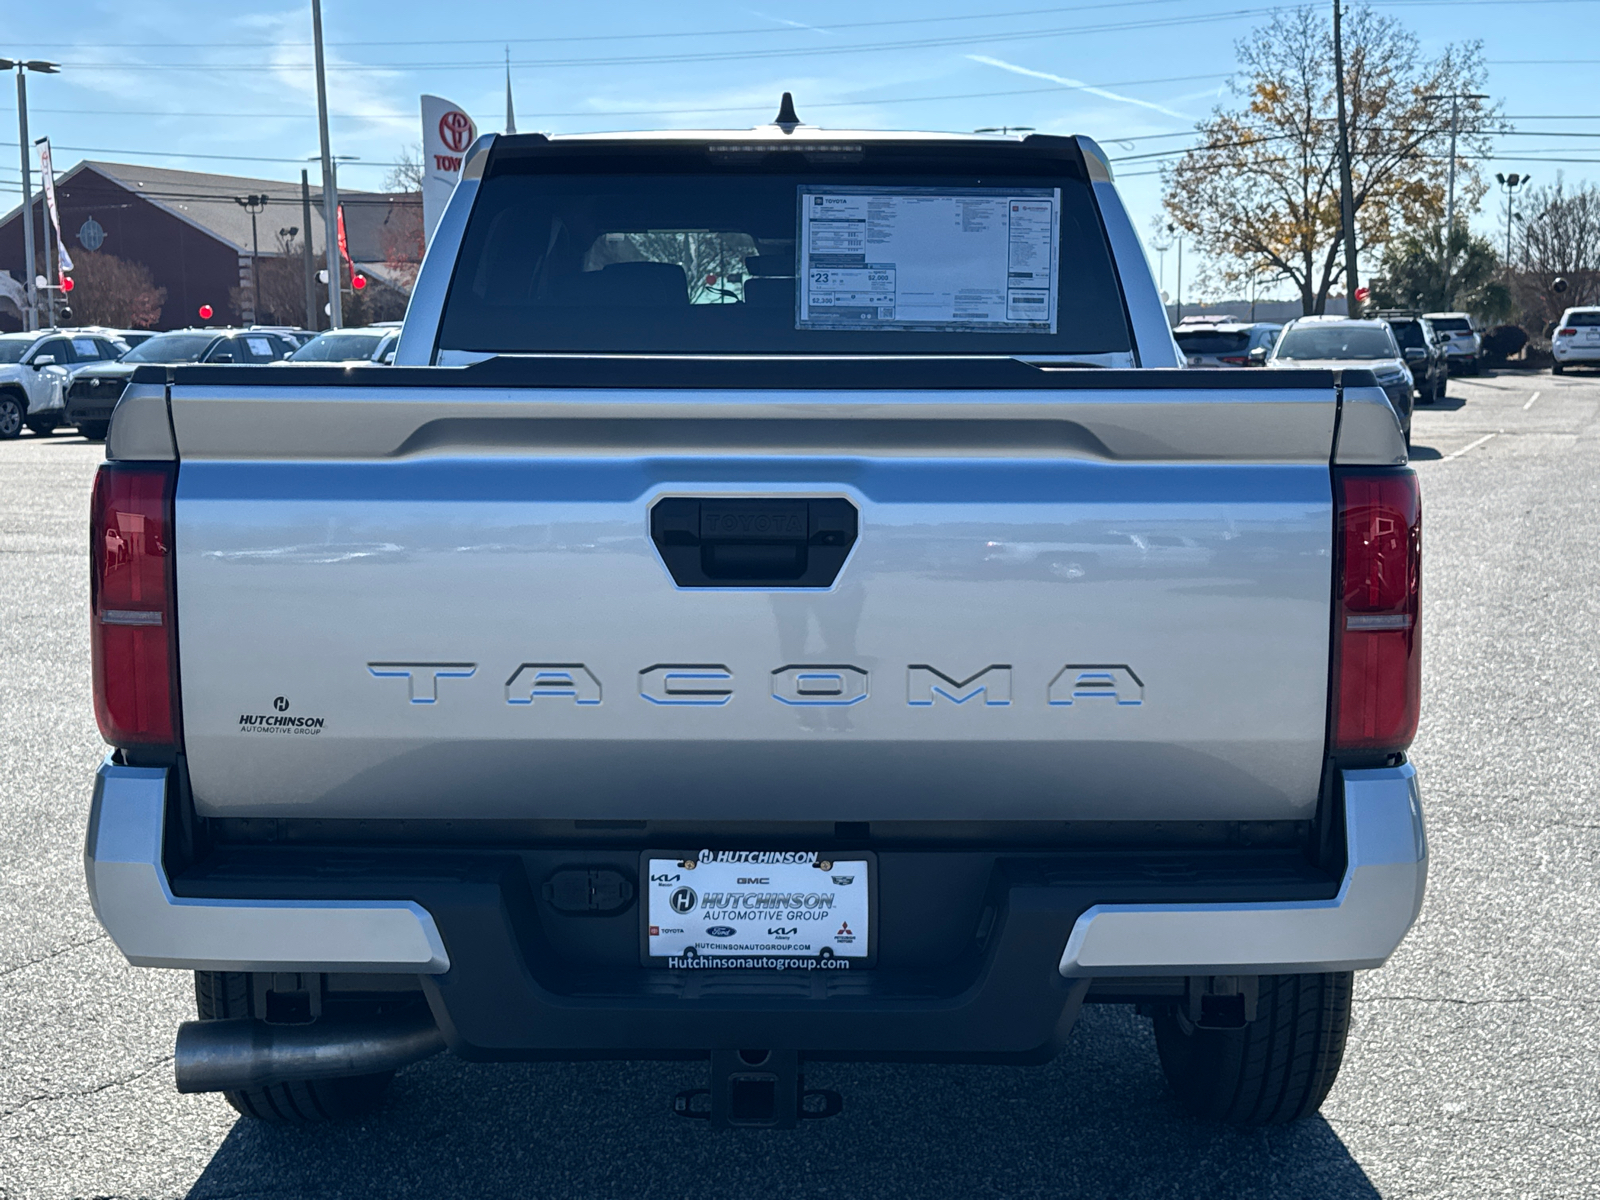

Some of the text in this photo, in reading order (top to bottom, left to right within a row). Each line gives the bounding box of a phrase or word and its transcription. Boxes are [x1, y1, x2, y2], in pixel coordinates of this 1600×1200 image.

[434, 154, 462, 172] TOY
[815, 273, 829, 283] 23
[706, 514, 803, 532] TOYOTA
[367, 662, 1144, 705] TACOMA
[239, 714, 325, 728] HUTCHINSON
[240, 725, 321, 735] AUTOMOTIVE GROUP
[716, 851, 818, 864] HUTCHINSON
[737, 877, 770, 885] GMC
[700, 892, 835, 910] HUTCHINSON
[703, 911, 829, 921] AUTOMOTIVE GROUP
[711, 927, 731, 936] Ford
[695, 942, 811, 951] HUTCHINSONAUTOGROUP.COM
[668, 956, 850, 971] Hutchinsonautogroup.com
